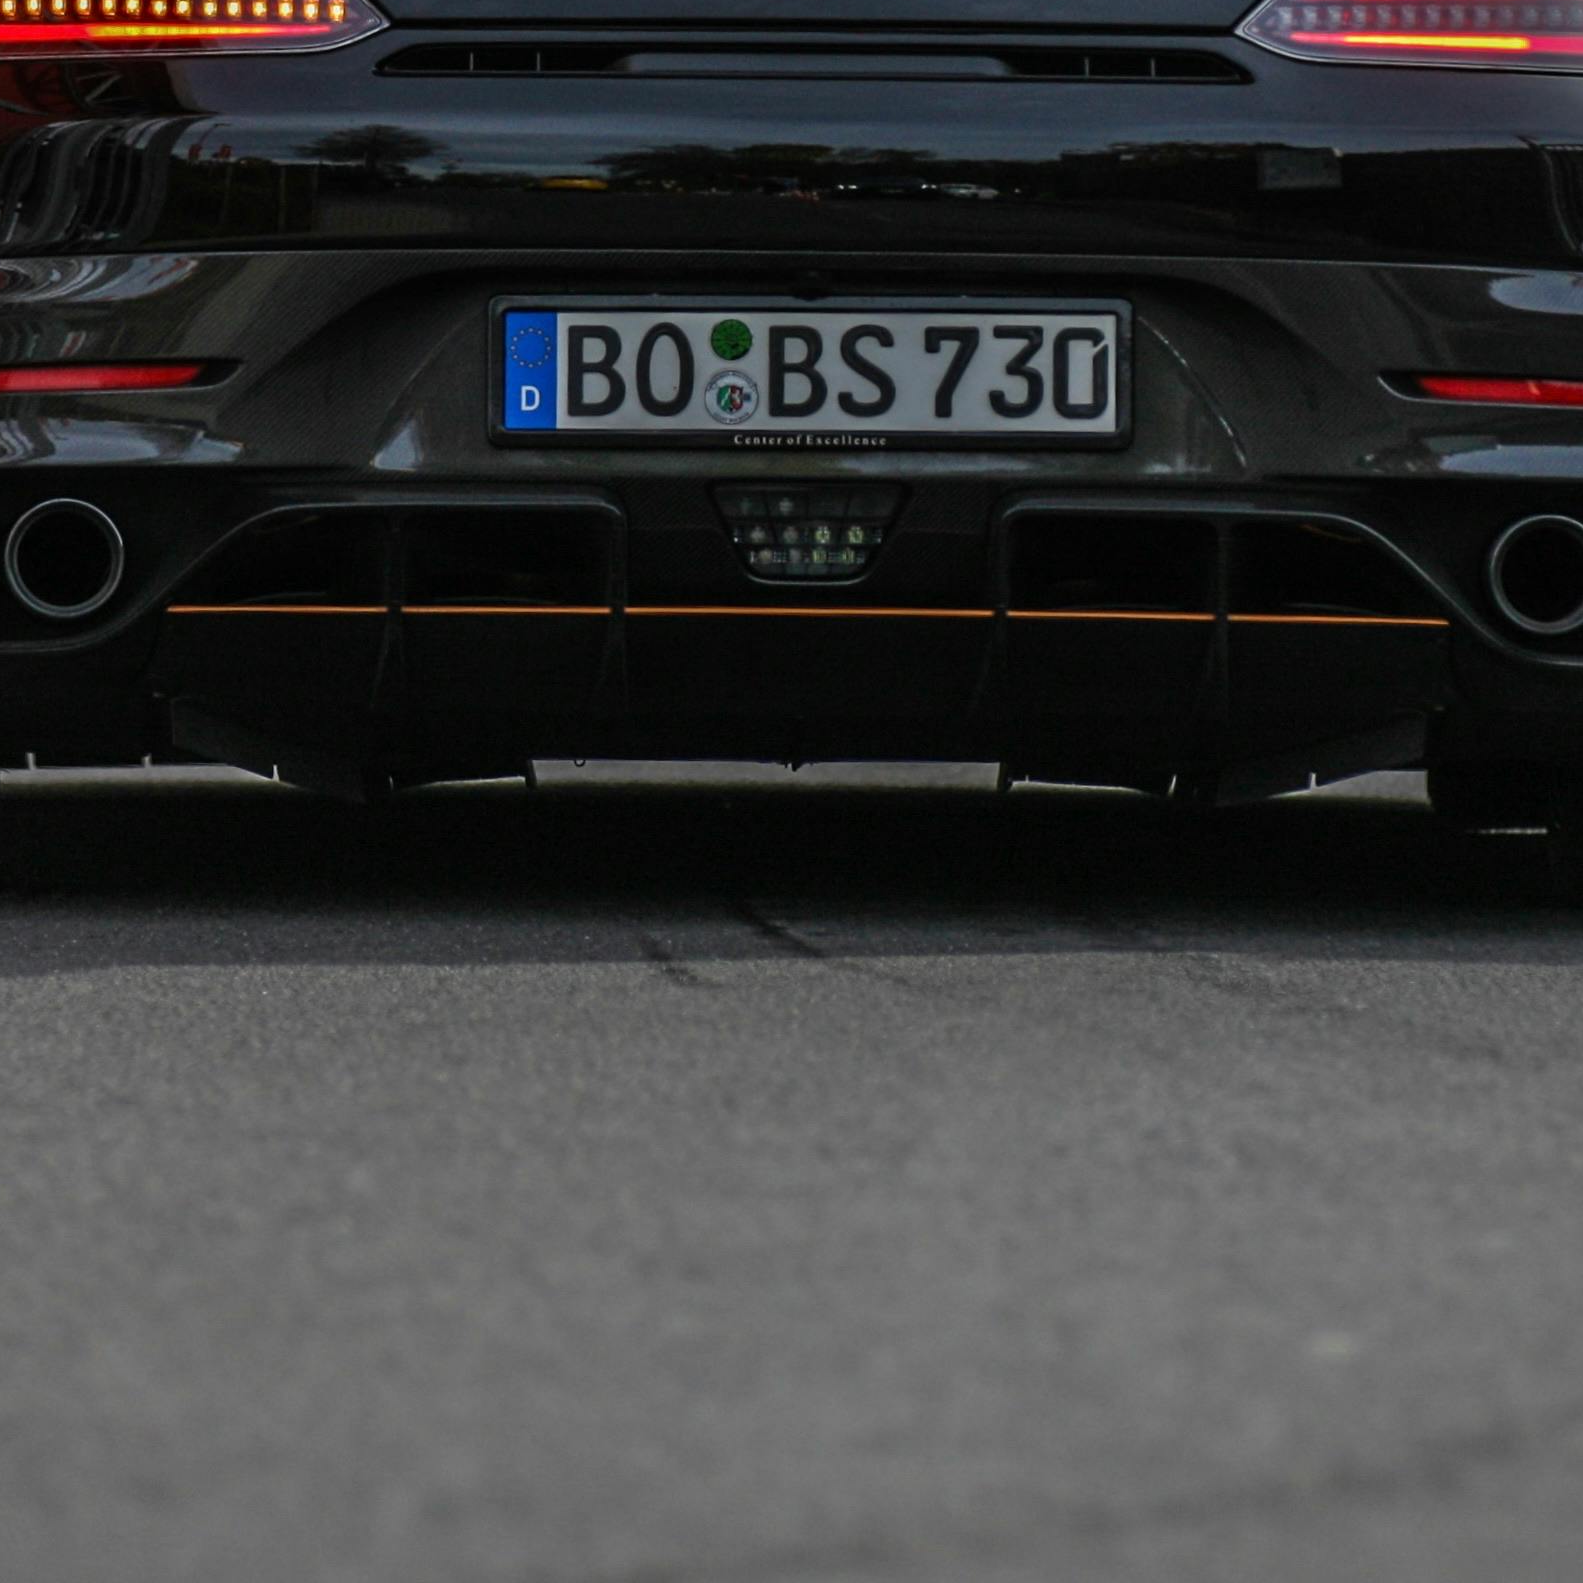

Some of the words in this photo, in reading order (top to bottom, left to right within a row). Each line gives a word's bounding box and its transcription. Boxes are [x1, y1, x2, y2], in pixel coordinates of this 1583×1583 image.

[567, 322, 695, 417] BO
[768, 324, 897, 417] BS
[923, 324, 1109, 419] 730
[520, 385, 541, 411] D
[733, 433, 782, 446] Center
[786, 433, 803, 446] of
[805, 433, 888, 446] Excellence
